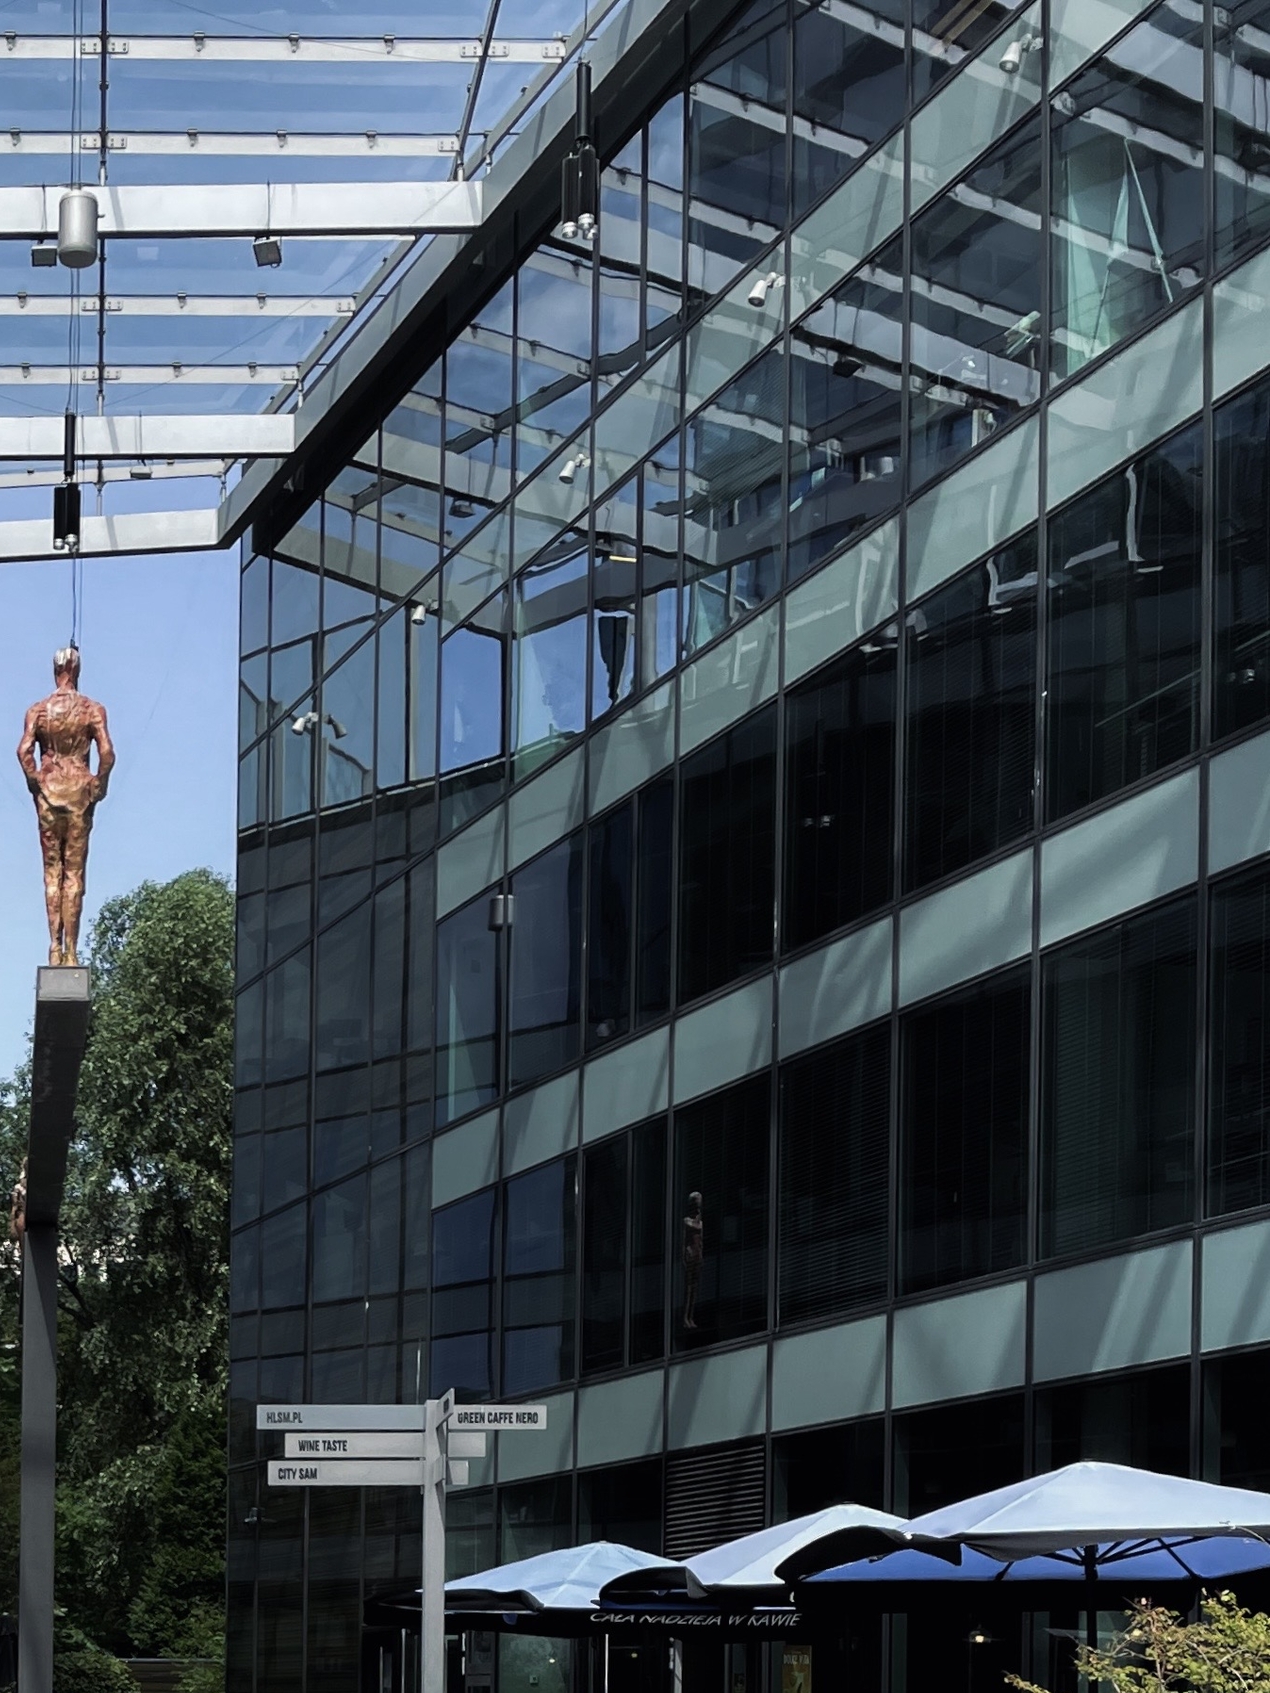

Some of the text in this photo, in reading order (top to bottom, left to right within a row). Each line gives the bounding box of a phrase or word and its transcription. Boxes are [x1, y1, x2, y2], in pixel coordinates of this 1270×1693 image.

[266, 1412, 303, 1424] HLSM.PL
[457, 1412, 539, 1424] GREEN CAFFE NERO
[298, 1440, 348, 1452] WINE TASTE
[278, 1468, 318, 1480] CITY SAM
[638, 1613, 721, 1626] NADZIEJA
[728, 1614, 746, 1626] W
[746, 1613, 803, 1627] KAWIE
